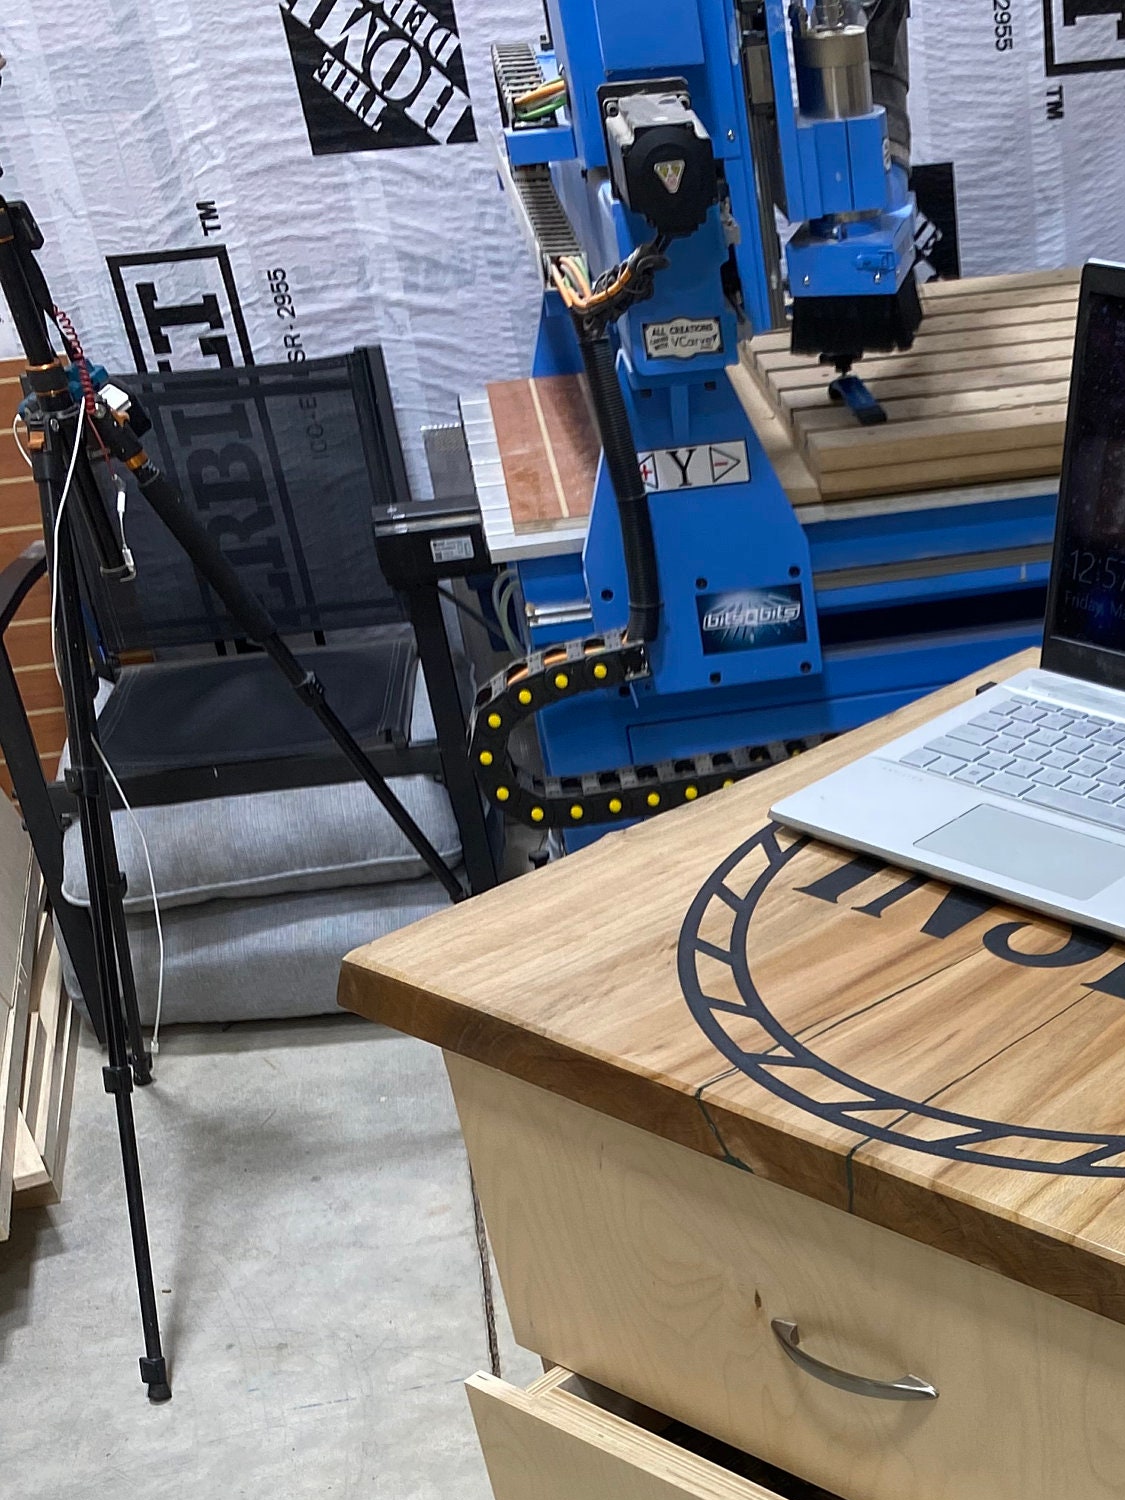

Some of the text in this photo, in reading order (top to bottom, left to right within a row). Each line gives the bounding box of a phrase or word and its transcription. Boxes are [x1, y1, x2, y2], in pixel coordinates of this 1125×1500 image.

[312, 51, 388, 133] THE
[1046, 85, 1065, 120] TM
[196, 200, 222, 236] TM
[666, 448, 698, 487] Y
